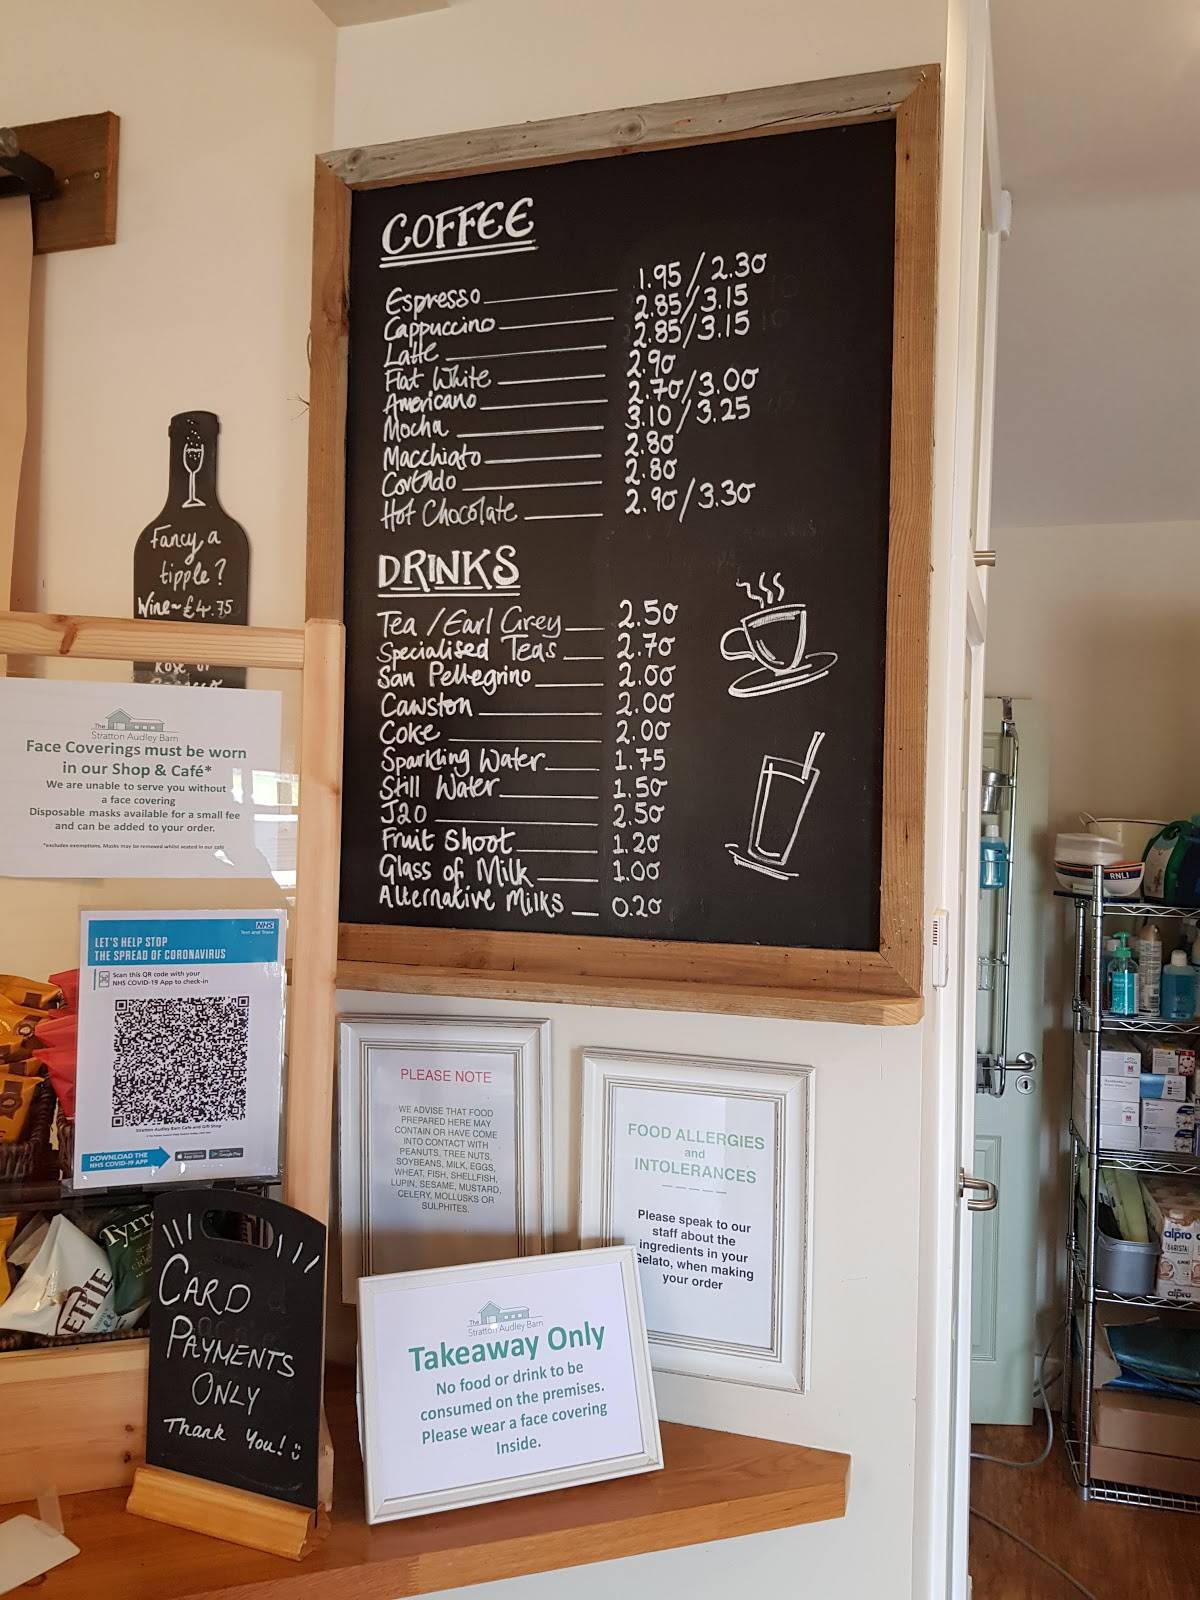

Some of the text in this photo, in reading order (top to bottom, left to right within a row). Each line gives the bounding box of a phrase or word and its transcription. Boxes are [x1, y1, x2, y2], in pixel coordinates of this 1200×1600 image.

[382, 197, 534, 254] COFFEE
[385, 287, 481, 320] Espresso
[384, 316, 496, 348] Cappuccino
[384, 341, 439, 368] Latte
[385, 350, 676, 392] Flat White 2.90
[383, 390, 477, 416] Americano
[384, 414, 449, 442] Mocha
[384, 430, 674, 471] Macchiato 2.80
[382, 458, 677, 497] Cortado 2.80
[380, 495, 518, 532] Hot Chocolate
[150, 524, 204, 565] Fancy
[378, 545, 520, 592] DRINKS
[376, 599, 679, 639] Tea Grey 2.50
[376, 632, 676, 671] Specialised Teas 2.70
[377, 661, 677, 695] San Pellegrino 2.00
[381, 691, 675, 717] Cawston 2.00
[127, 732, 157, 743] Audley
[379, 719, 671, 745] Coke 2.00
[26, 740, 247, 759] Face Coverings must be worn
[380, 746, 666, 777] Sparkling Water 1.75
[62, 761, 77, 773] in
[81, 764, 108, 774] our
[112, 762, 151, 778] Shop
[46, 780, 227, 793] We are unable serve you without
[379, 773, 668, 800] Still Water 1.50
[29, 807, 241, 820] Disposable masks available for small fee
[613, 802, 666, 828] 2.50
[382, 826, 660, 855] Fruit Shoot 1.20
[379, 853, 660, 889] Glass of Milk 1.00
[1110, 871, 1130, 880] RNLI
[379, 885, 662, 918] Alternative Milks 0.20
[94, 936, 168, 948] LET'S HELP STOP
[94, 948, 226, 961] THE SPREAD OF CORONAVIRUS
[400, 1069, 492, 1083] PLEASE NOTE
[399, 1105, 494, 1117] WE ADVISE THAT FOOD
[401, 1116, 492, 1128] PREPARED HERE MAY
[394, 1126, 498, 1139] CONTAIN OR HAVE COME
[403, 1137, 489, 1149] INTO CONTACT WITH
[628, 1122, 765, 1150] FOOD ALLERGIES
[684, 1147, 705, 1159] and
[634, 1157, 757, 1184] INTOLERANCES
[458, 1183, 502, 1195] MUSTARD,
[637, 1209, 751, 1233] Please speak our
[1164, 1228, 1192, 1241] alpro
[652, 1227, 736, 1246] staff about the
[639, 1239, 748, 1263] ingredients your
[662, 1272, 723, 1290] your order
[676, 1259, 707, 1273] when
[711, 1264, 754, 1281] making
[158, 1252, 251, 1316] CARD
[166, 1314, 296, 1378] PAYMENTS
[408, 1321, 605, 1372] Takeaway Only
[436, 1361, 584, 1396] No food or drink be
[191, 1371, 261, 1416] ONLY
[420, 1381, 605, 1421] consumed on the premises.
[163, 1417, 287, 1456] Thank You!
[422, 1402, 608, 1444] Please wear face covering
[496, 1436, 541, 1455] Inside.
